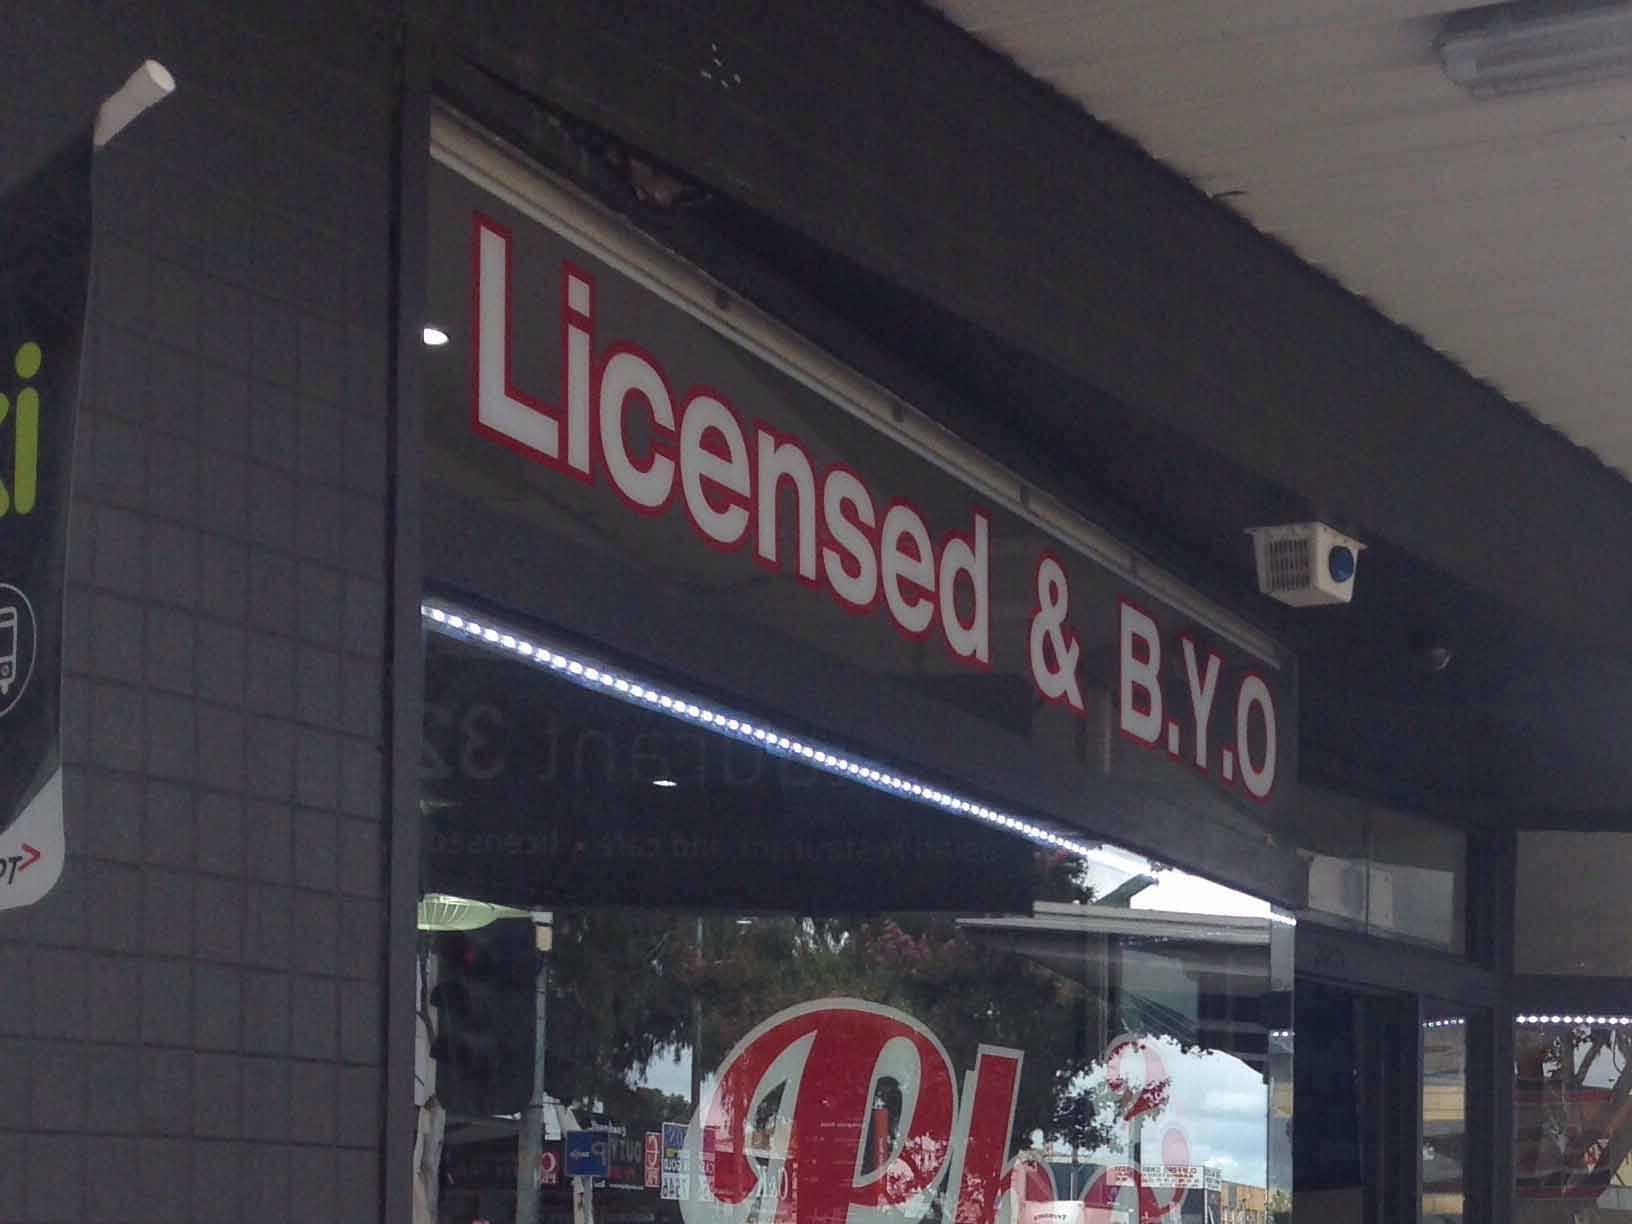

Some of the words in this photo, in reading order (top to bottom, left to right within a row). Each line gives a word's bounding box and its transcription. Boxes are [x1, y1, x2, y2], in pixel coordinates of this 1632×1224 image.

[473, 211, 992, 674] Licensed
[1028, 551, 1086, 718] &
[1118, 600, 1279, 801] B.Y.O
